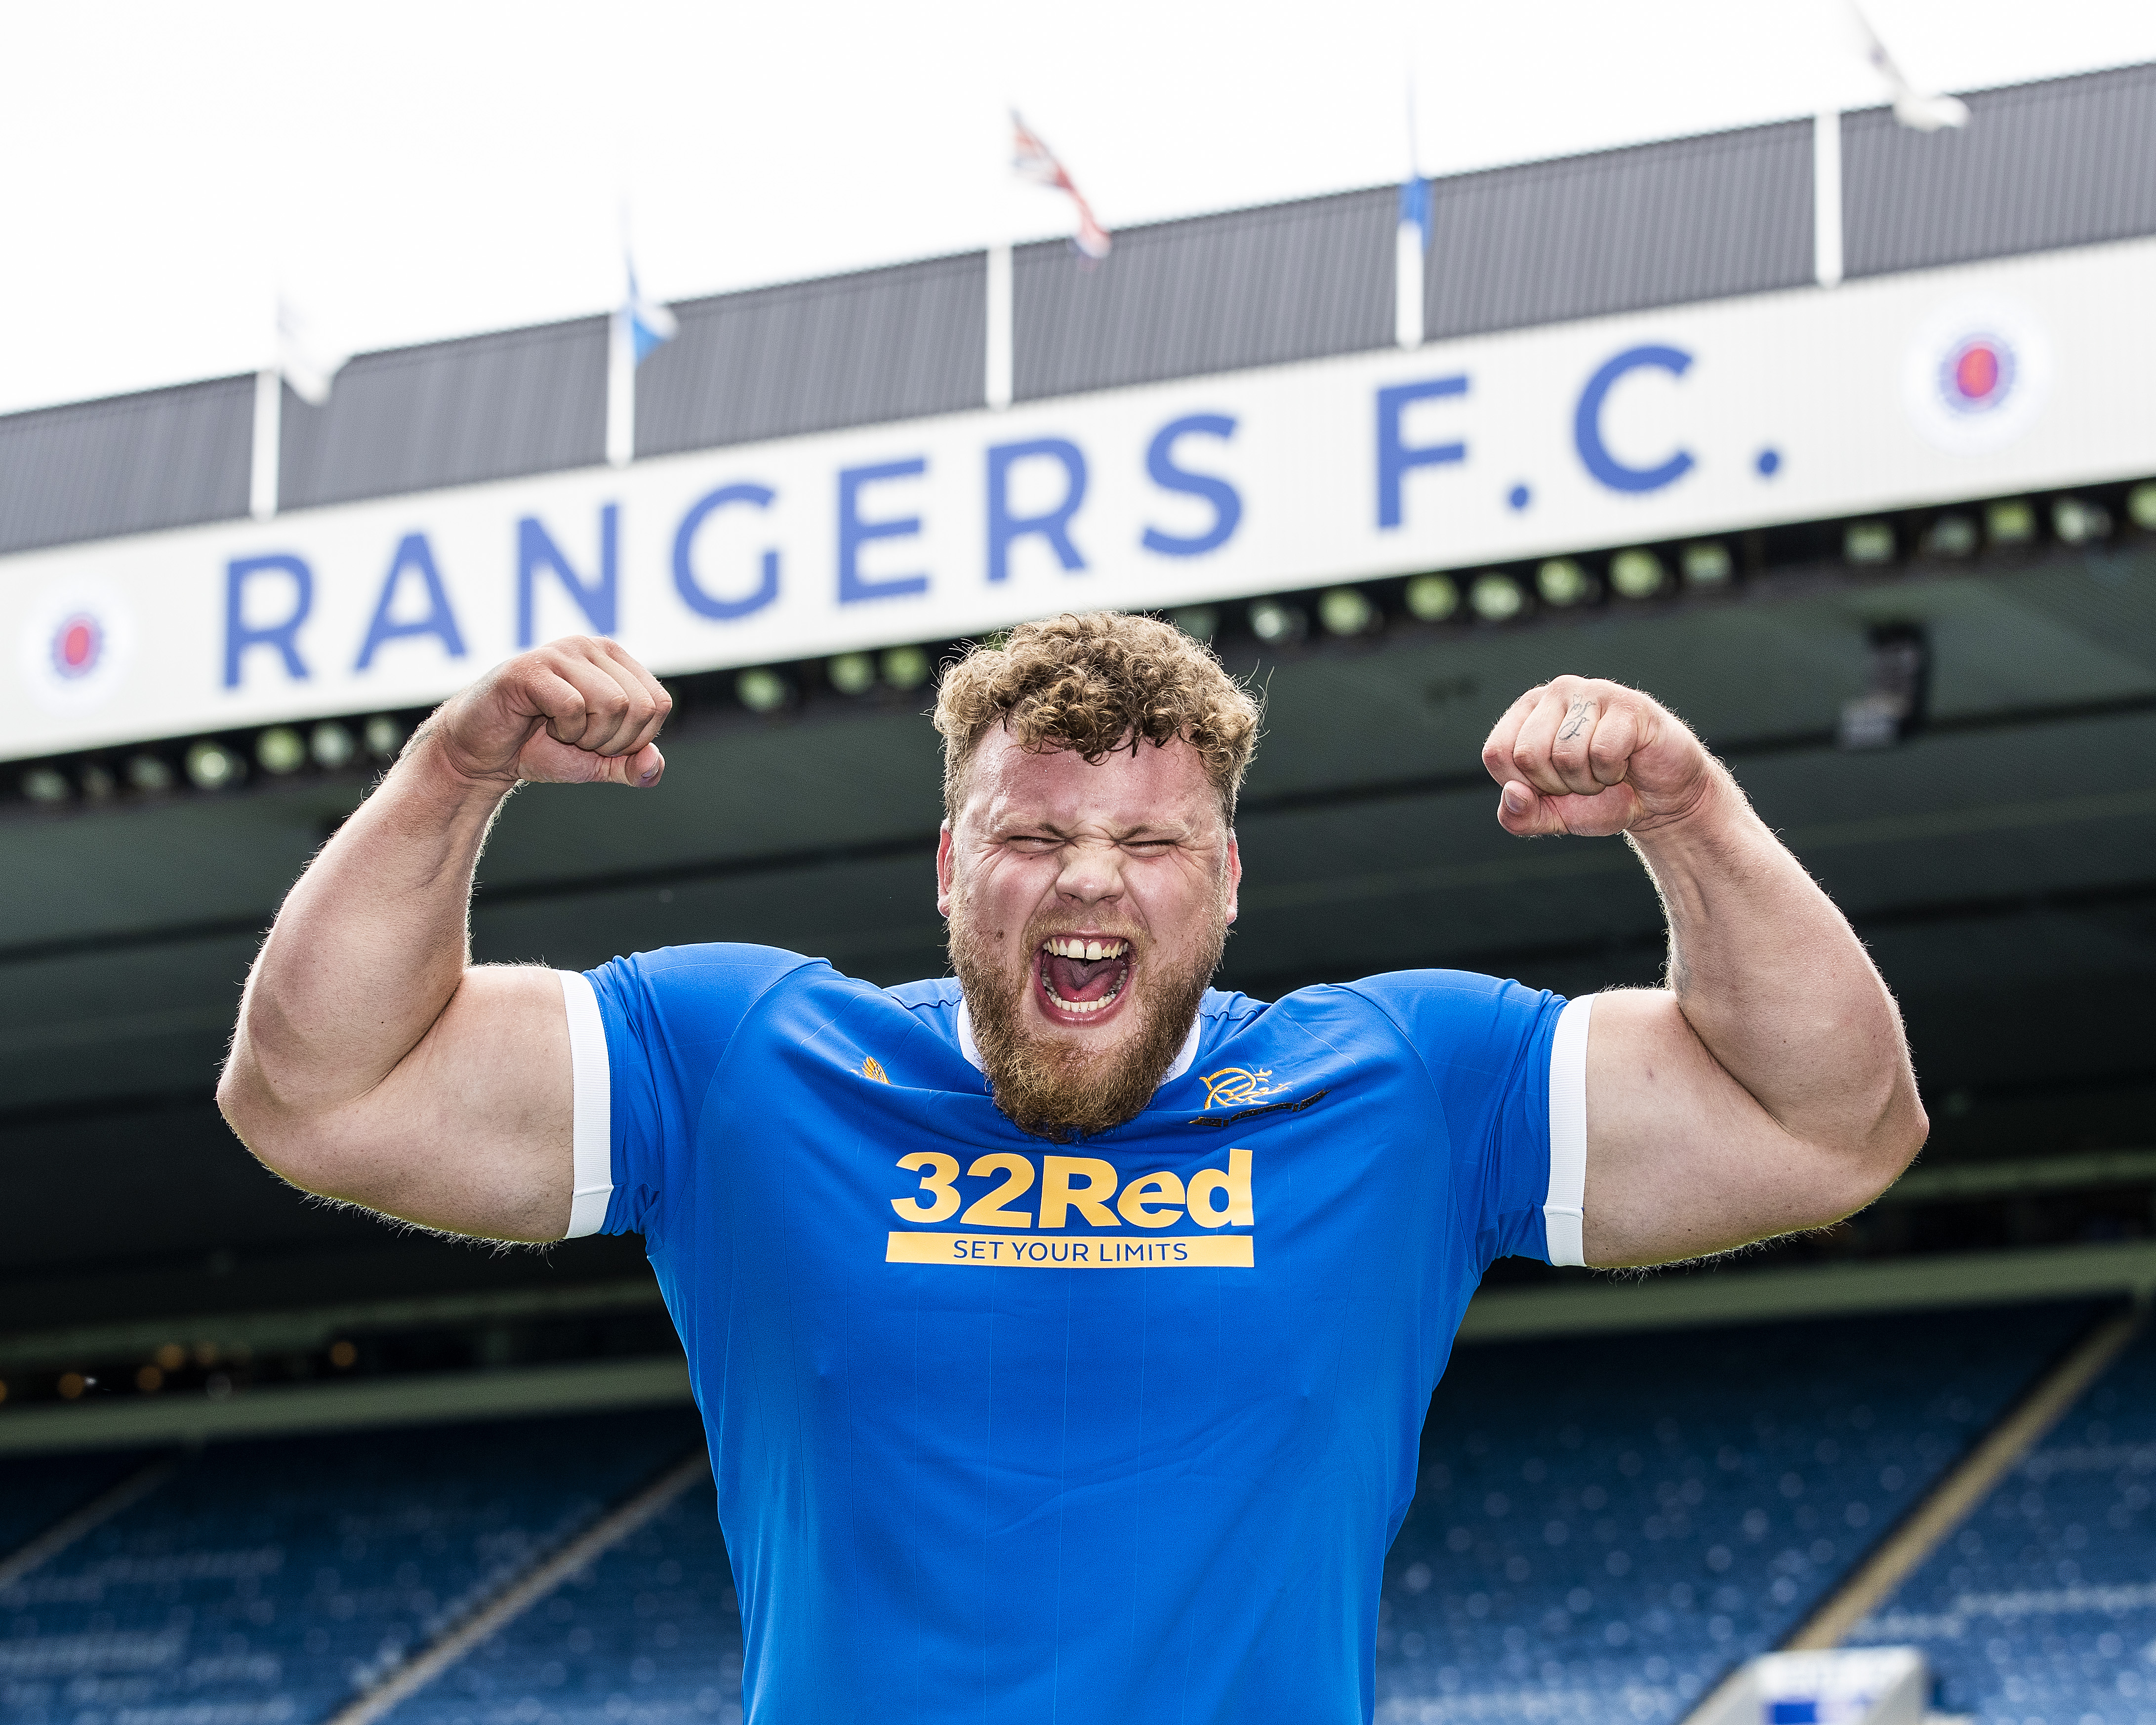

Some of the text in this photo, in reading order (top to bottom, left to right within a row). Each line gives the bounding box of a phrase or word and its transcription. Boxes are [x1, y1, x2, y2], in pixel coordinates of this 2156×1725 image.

[221, 342, 1783, 691] RANGERS F.C.
[890, 1148, 1255, 1229] 32Red
[953, 1240, 1188, 1262] SET YOUR LIMITS
